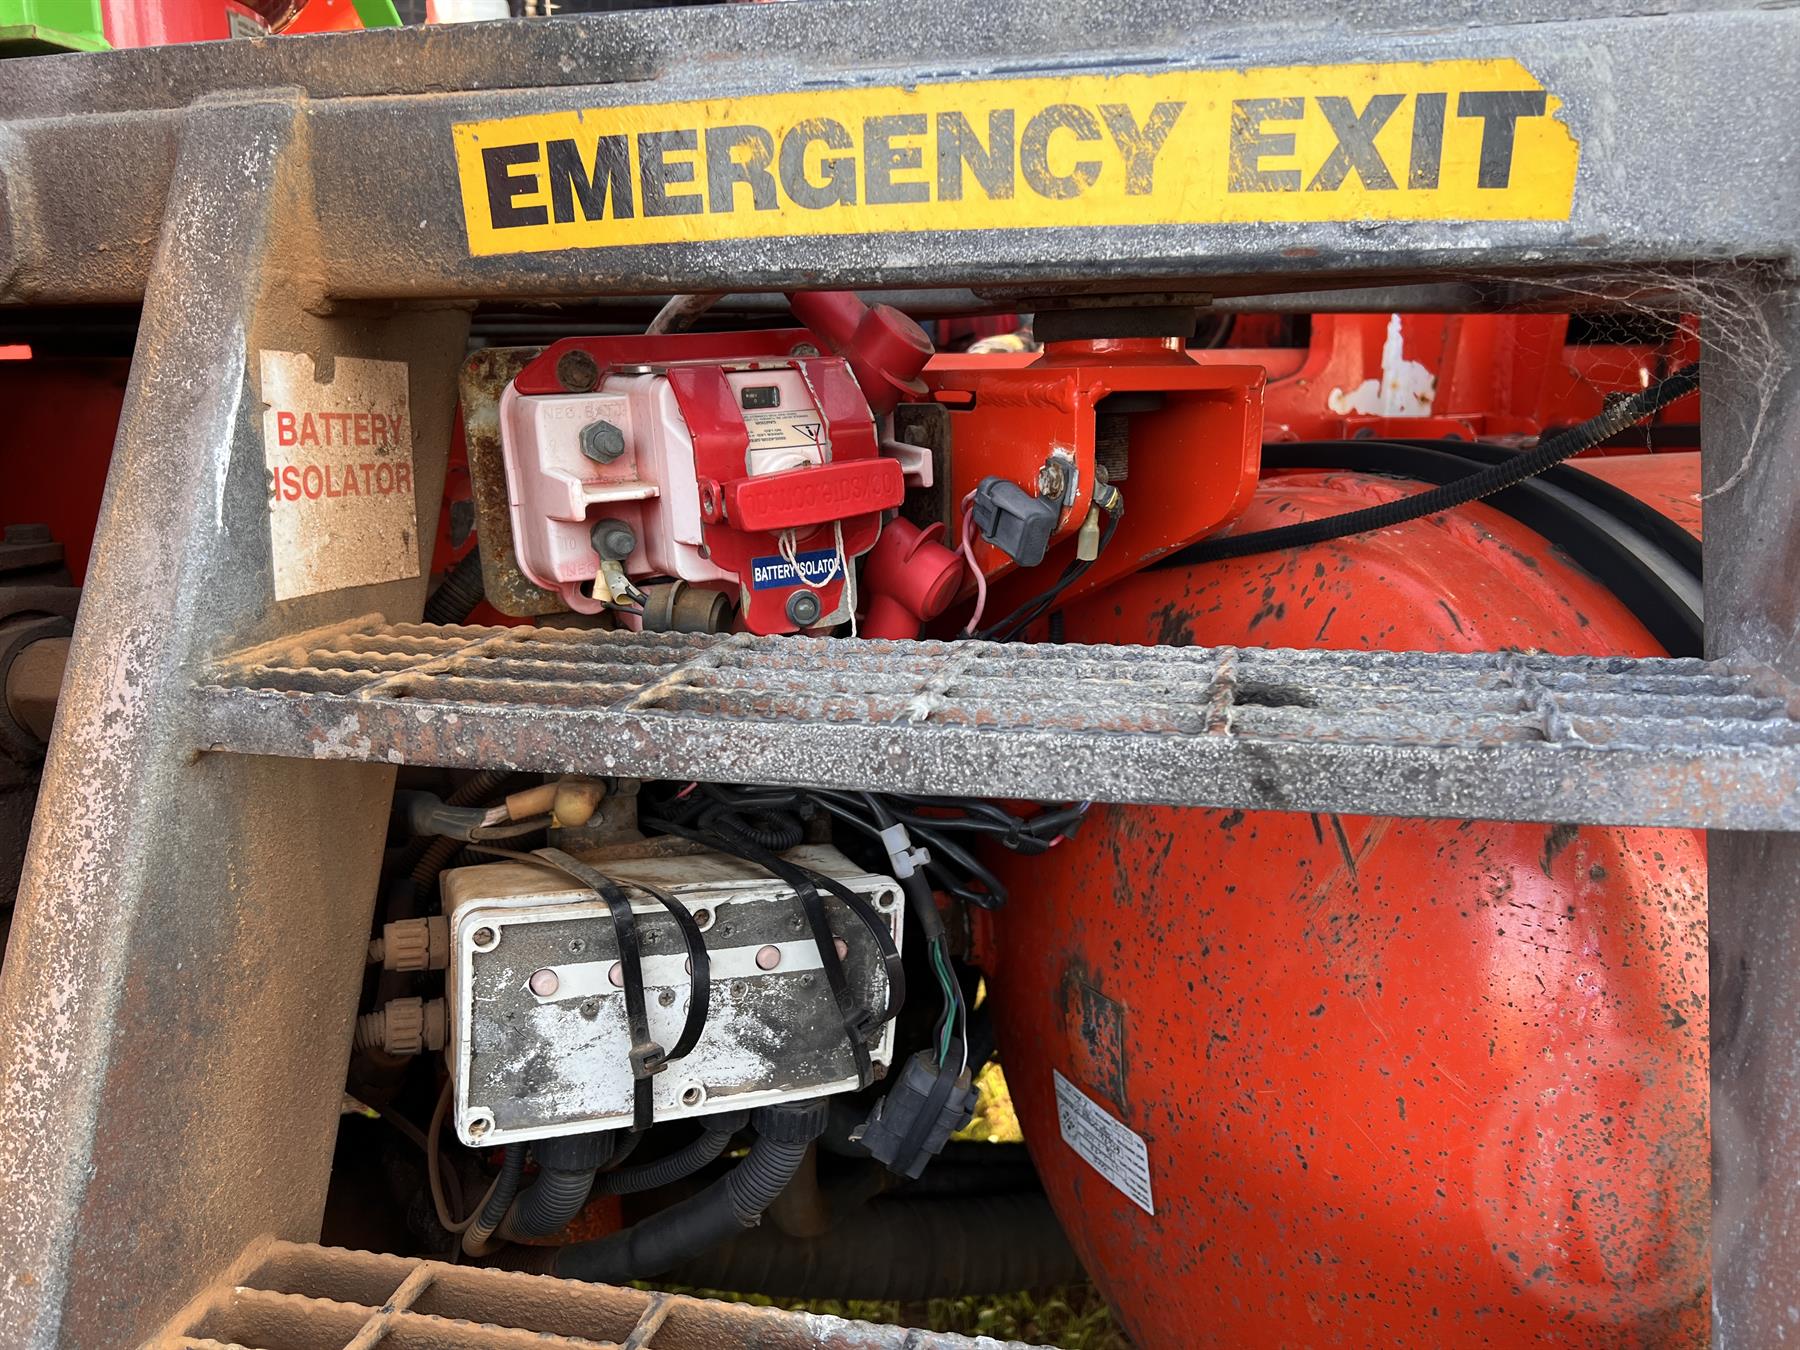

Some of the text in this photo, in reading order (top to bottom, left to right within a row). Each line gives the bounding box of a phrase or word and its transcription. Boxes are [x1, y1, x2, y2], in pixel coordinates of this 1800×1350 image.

[482, 90, 1547, 229] EMERGENCY EXIT
[277, 411, 403, 446] BATTERY
[273, 462, 411, 501] ISOLATOR
[754, 563, 795, 582] BATTERY
